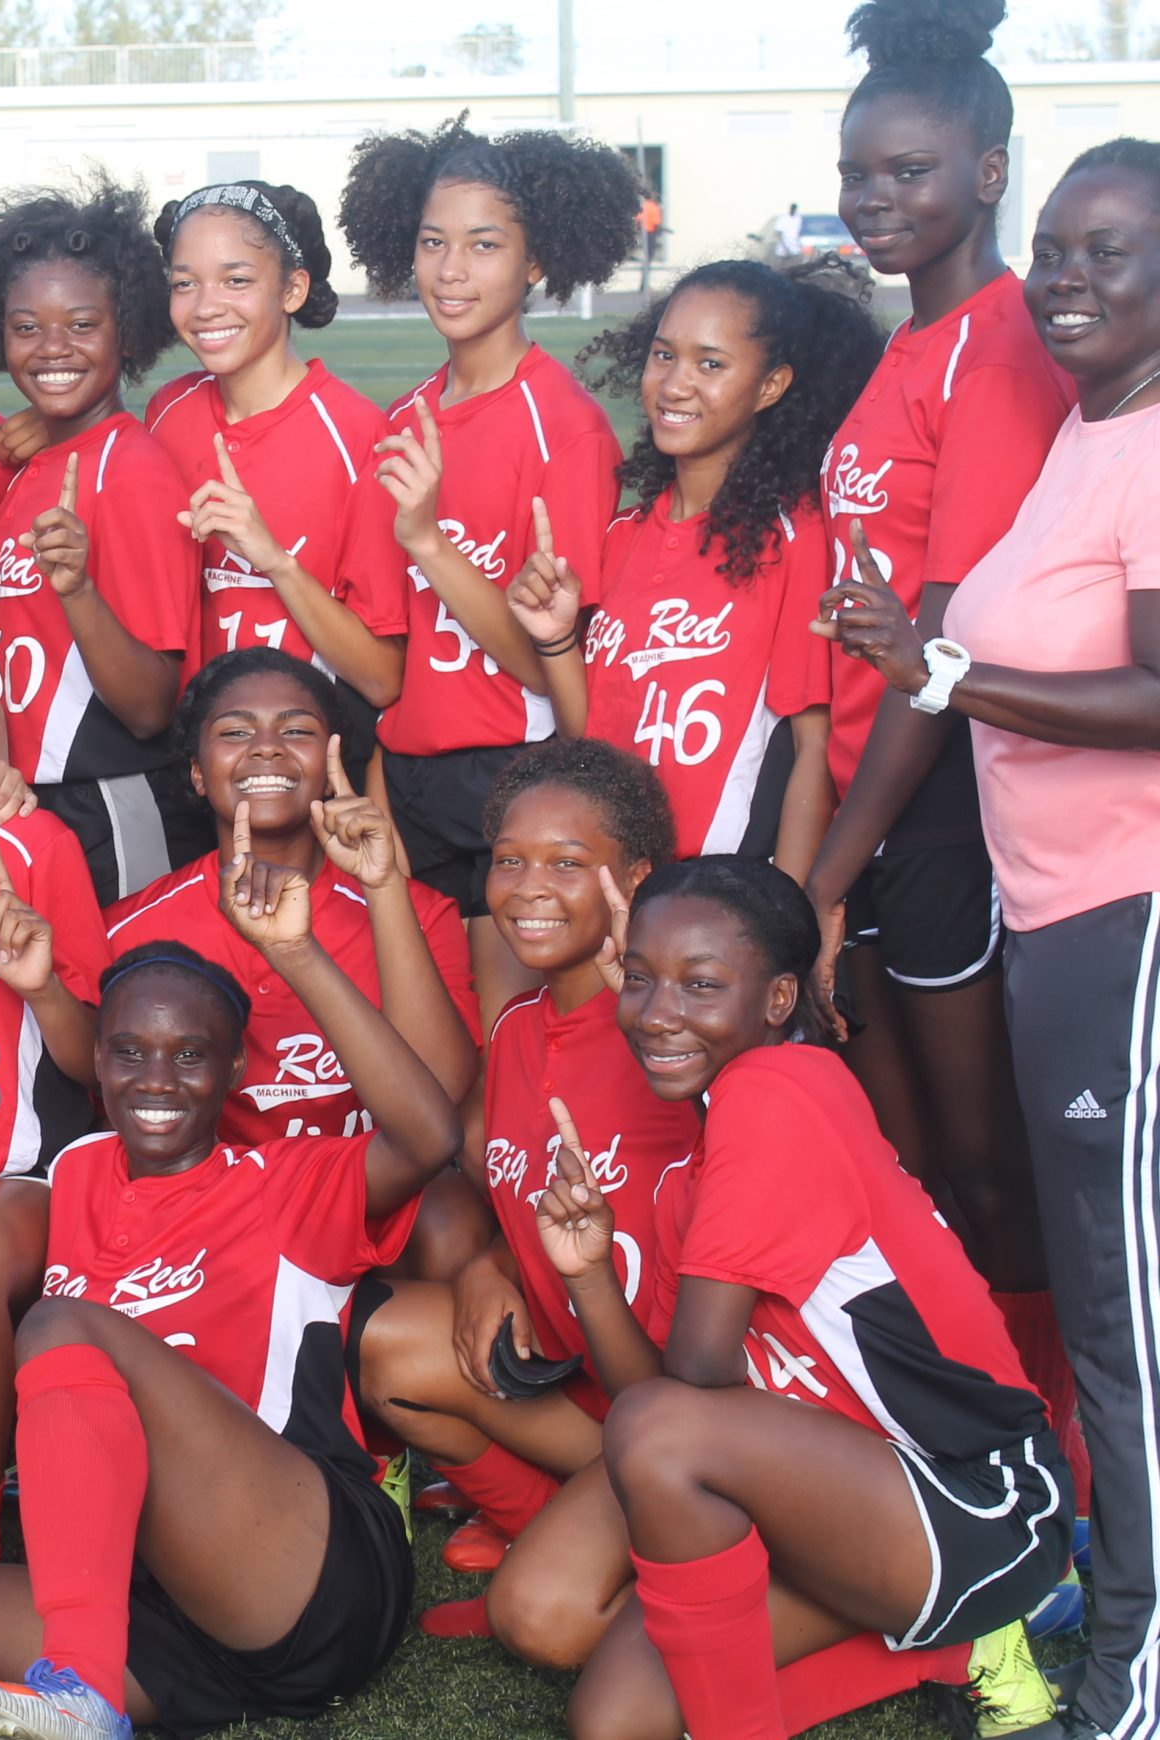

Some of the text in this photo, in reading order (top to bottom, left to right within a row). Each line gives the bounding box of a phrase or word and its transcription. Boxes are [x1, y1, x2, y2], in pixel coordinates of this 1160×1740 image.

[834, 443, 893, 505] Red
[585, 599, 734, 667] Big Red
[634, 679, 726, 767] 46
[256, 1088, 309, 1098] MACHINE
[1064, 1108, 1108, 1119] adidas
[485, 1132, 623, 1200] Big Rd
[109, 1247, 208, 1304] Red
